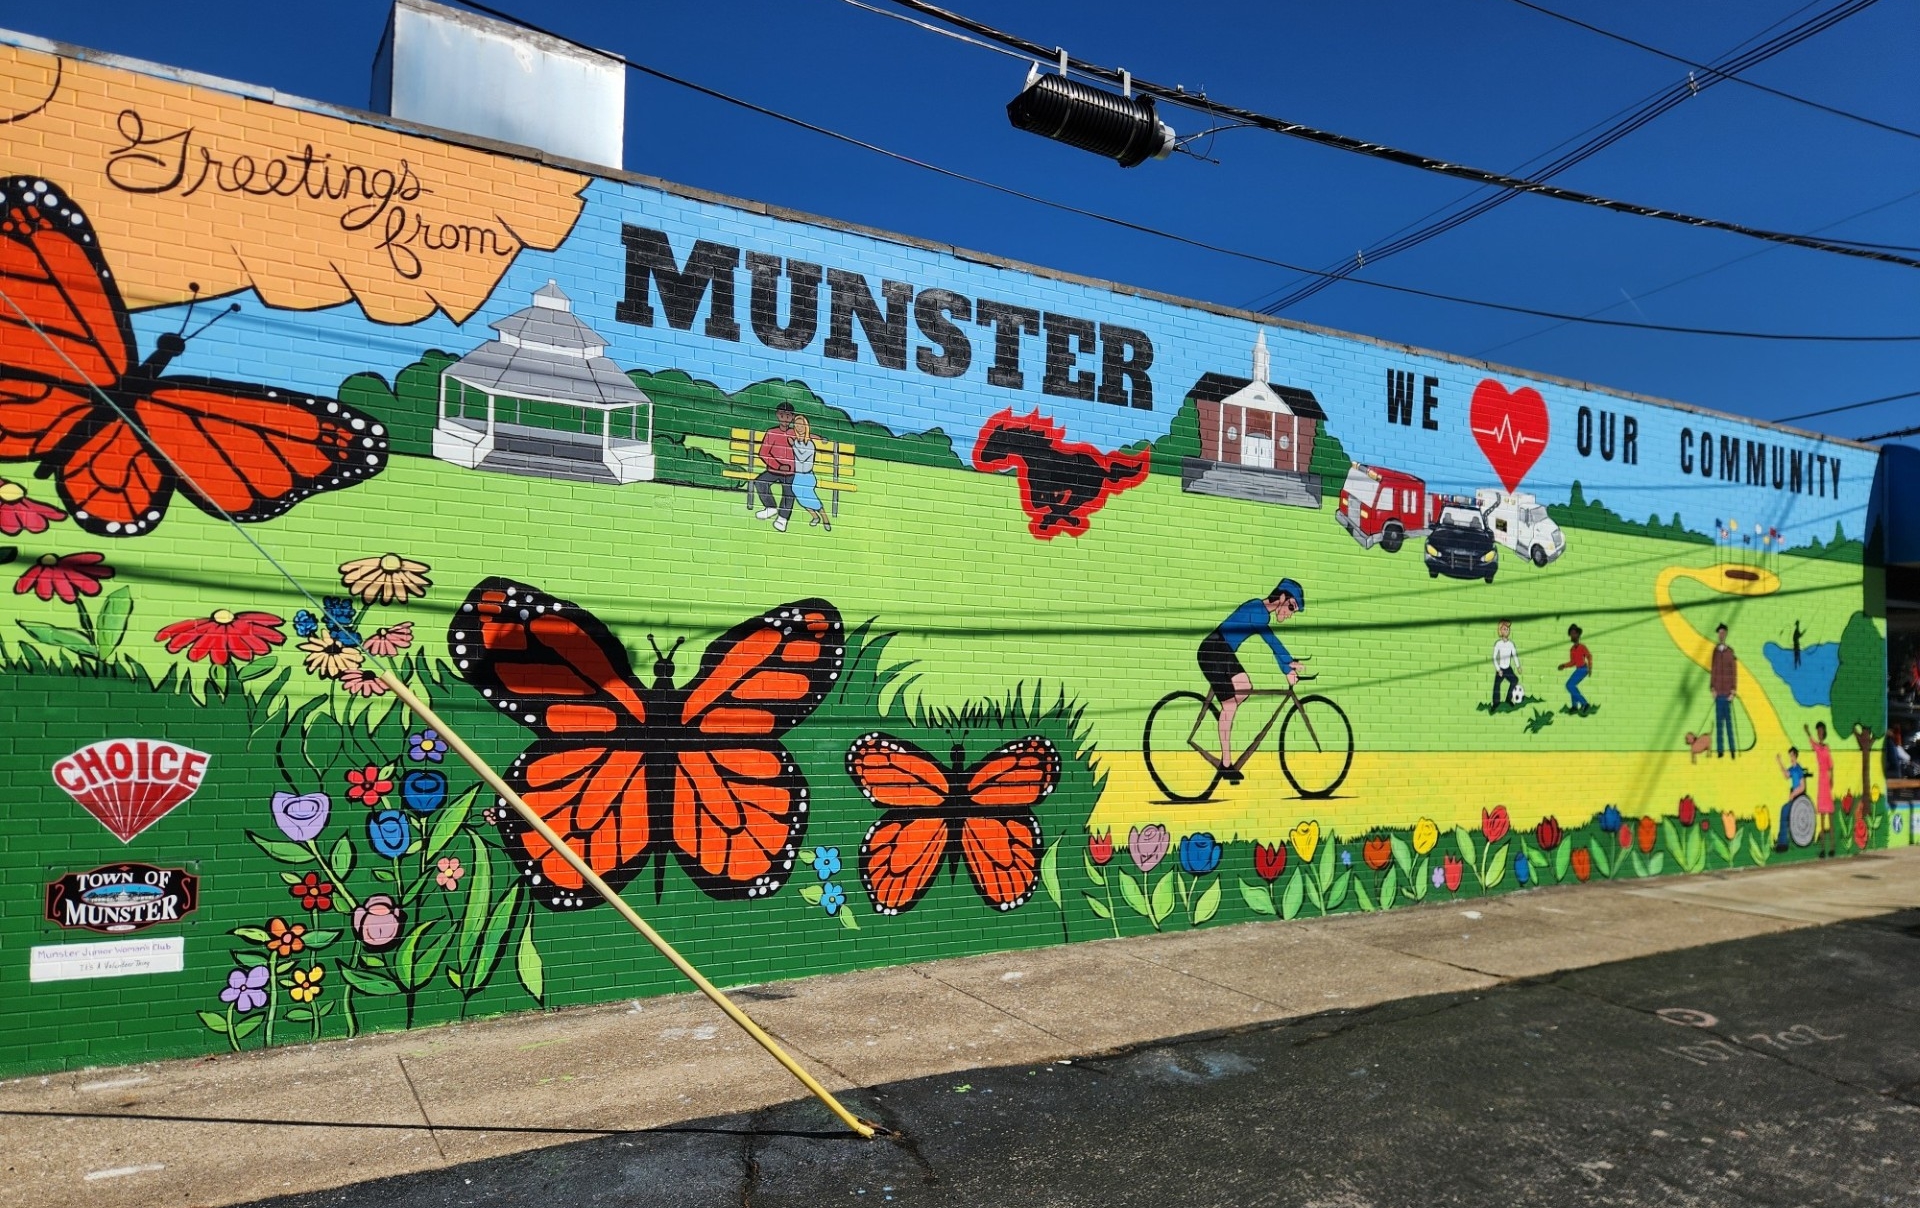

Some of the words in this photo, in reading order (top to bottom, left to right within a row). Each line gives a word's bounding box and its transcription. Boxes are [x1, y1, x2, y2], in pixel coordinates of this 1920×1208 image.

[106, 110, 434, 231] Greetings
[376, 206, 513, 280] from
[615, 222, 1154, 411] MUNSTER
[1386, 368, 1439, 431] WE
[1577, 405, 1639, 465] OUR
[1680, 427, 1842, 500] COMMUNITY
[53, 741, 208, 793] CHOICE
[65, 894, 178, 926] MUNSTER
[77, 872, 134, 892] TOWN
[144, 870, 172, 888] OF
[37, 949, 79, 959] Munster
